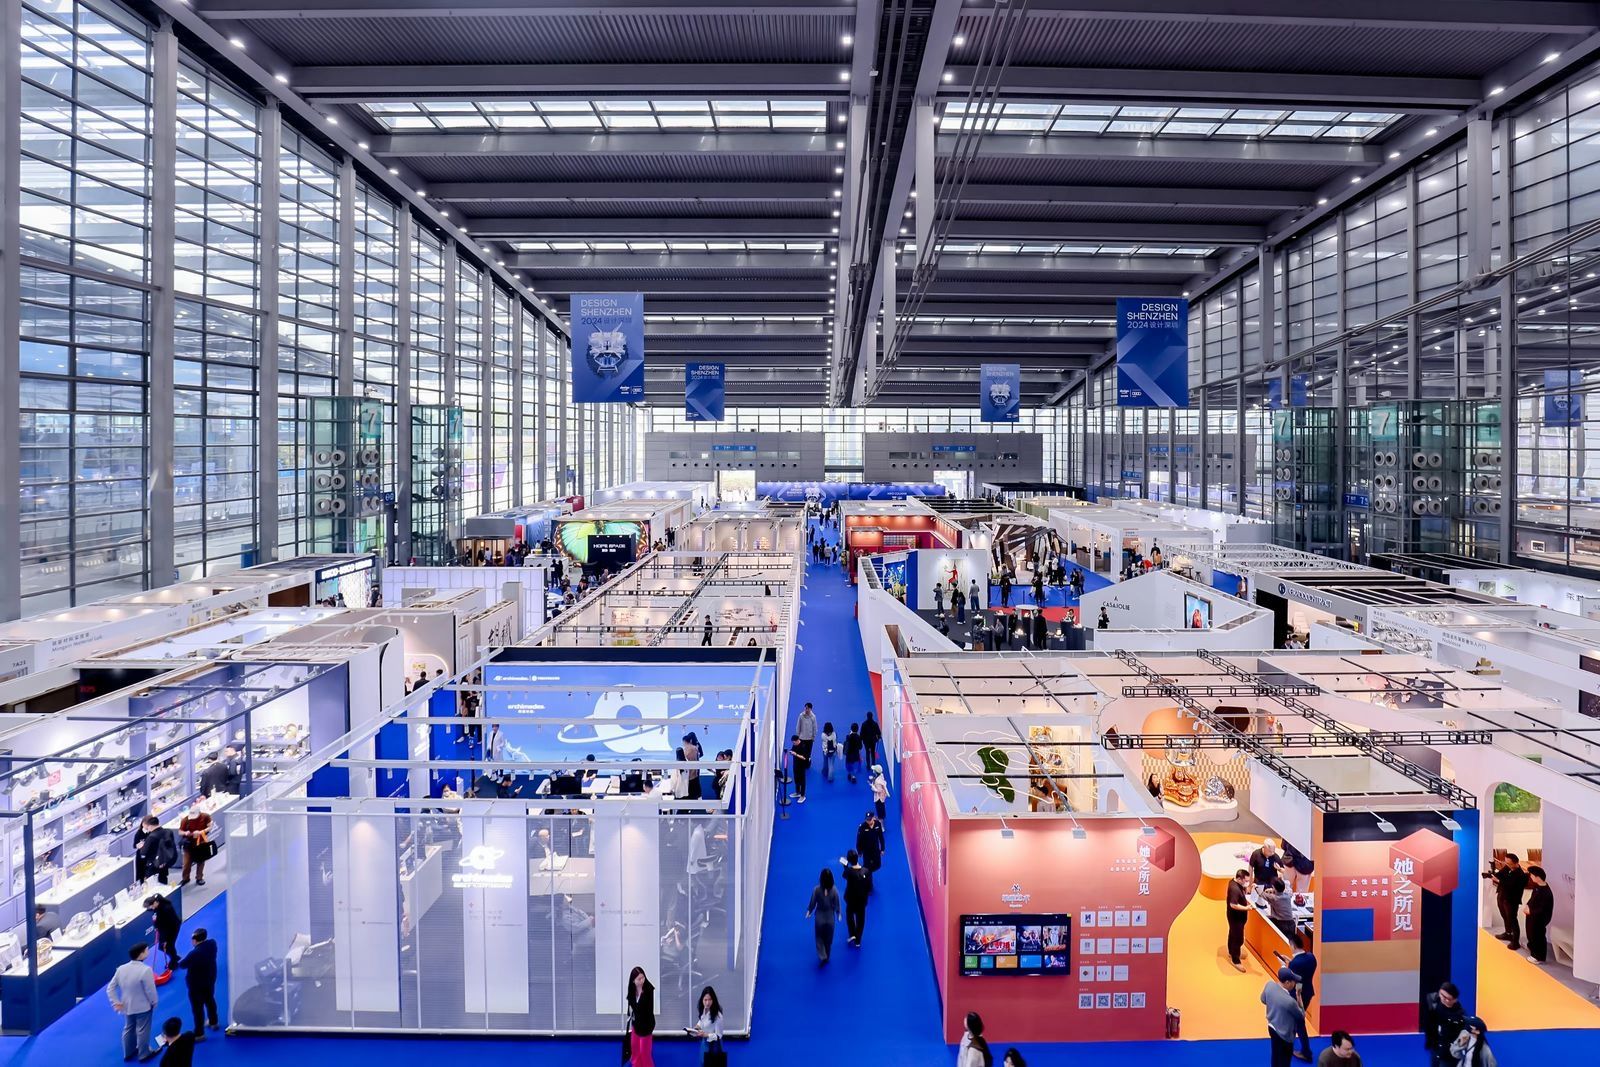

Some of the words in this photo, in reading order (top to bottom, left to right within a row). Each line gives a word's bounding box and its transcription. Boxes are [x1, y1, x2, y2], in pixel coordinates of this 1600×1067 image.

[581, 299, 617, 307] DESIGN
[1141, 303, 1178, 311] DESIGN
[581, 308, 632, 316] SHENZHEN
[1127, 312, 1178, 320] SHENZHEN
[581, 317, 602, 325] 2024
[1127, 321, 1149, 329] 2024
[1277, 416, 1287, 436] 7
[1376, 412, 1390, 435] 7
[1138, 845, 1151, 896] 她之所见
[1392, 857, 1414, 932] 她之所见
